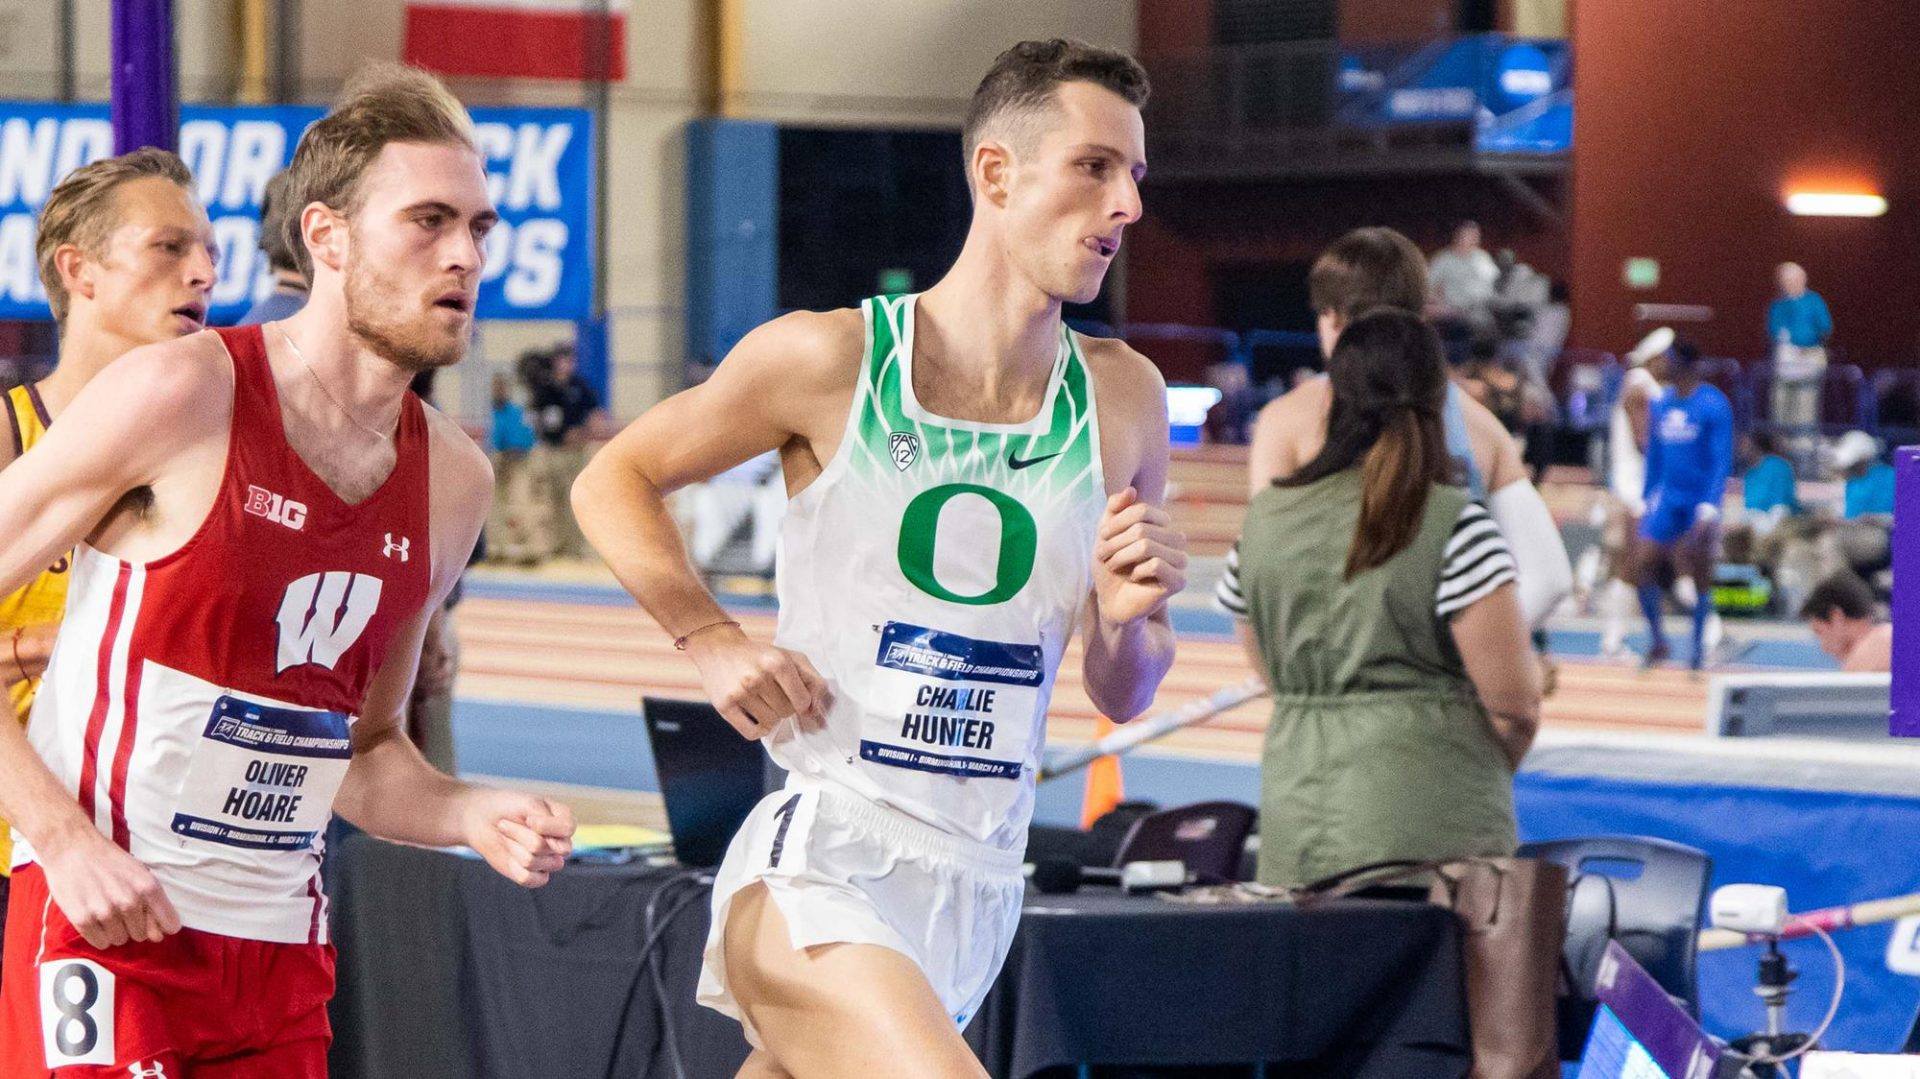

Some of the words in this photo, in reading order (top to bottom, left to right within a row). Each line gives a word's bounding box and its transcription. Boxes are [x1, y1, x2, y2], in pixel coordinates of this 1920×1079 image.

[891, 434, 918, 456] PAC
[896, 449, 911, 463] 12
[898, 483, 1037, 605] O
[275, 571, 383, 676] W
[908, 652, 939, 667] TRACK
[939, 658, 947, 669] &
[947, 660, 974, 673] FIELD
[971, 665, 1038, 680] CHAMPIONSHIPS
[916, 684, 996, 713] CHARLIE
[236, 726, 265, 742] TRACK
[264, 733, 272, 743] &
[271, 733, 294, 746] FIELD
[292, 736, 350, 750] CHAMPIONSHIPS
[901, 713, 995, 750] HUNTER
[245, 759, 308, 788] OLIVER
[878, 748, 910, 761] DIVISION
[968, 762, 992, 772] MARCH
[222, 787, 302, 823] HOARE
[190, 821, 219, 835] DIVISION
[769, 793, 802, 868] 1
[53, 963, 98, 1057] 8
